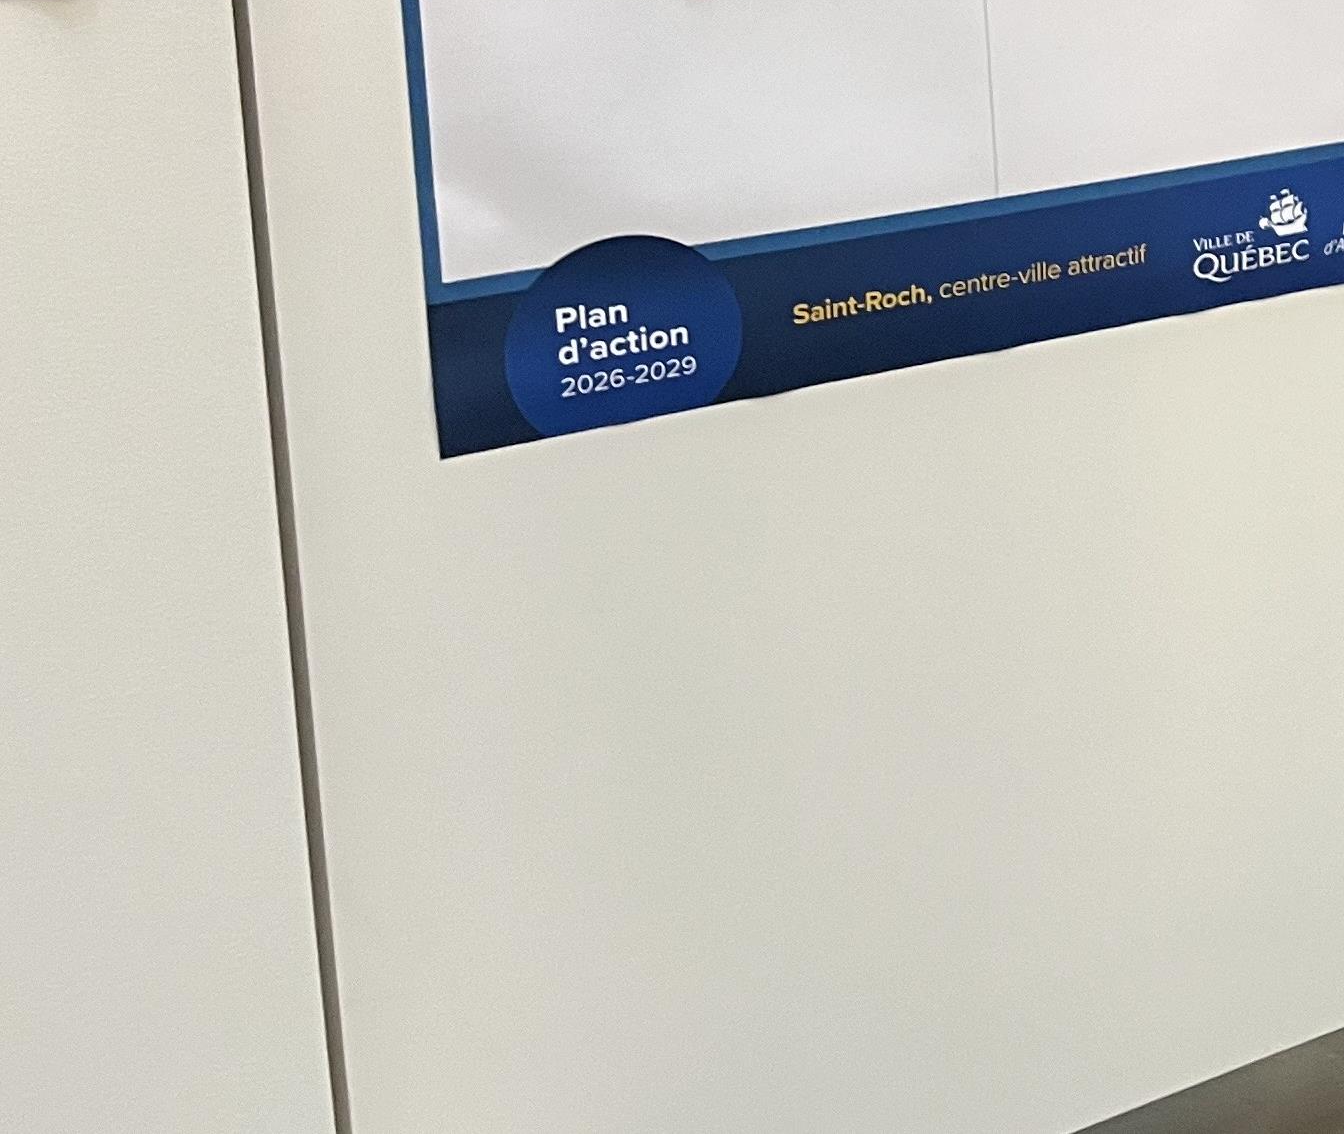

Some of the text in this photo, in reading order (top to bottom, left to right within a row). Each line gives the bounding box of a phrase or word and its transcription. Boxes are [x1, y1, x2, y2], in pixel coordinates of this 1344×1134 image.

[1193, 230, 1256, 251] VILLE DE
[1193, 239, 1310, 283] QUÉBEC
[793, 243, 1146, 324] Saint-Roch, centre-ville attractif
[555, 304, 627, 333] Plan
[561, 356, 697, 397] 2026-2029
